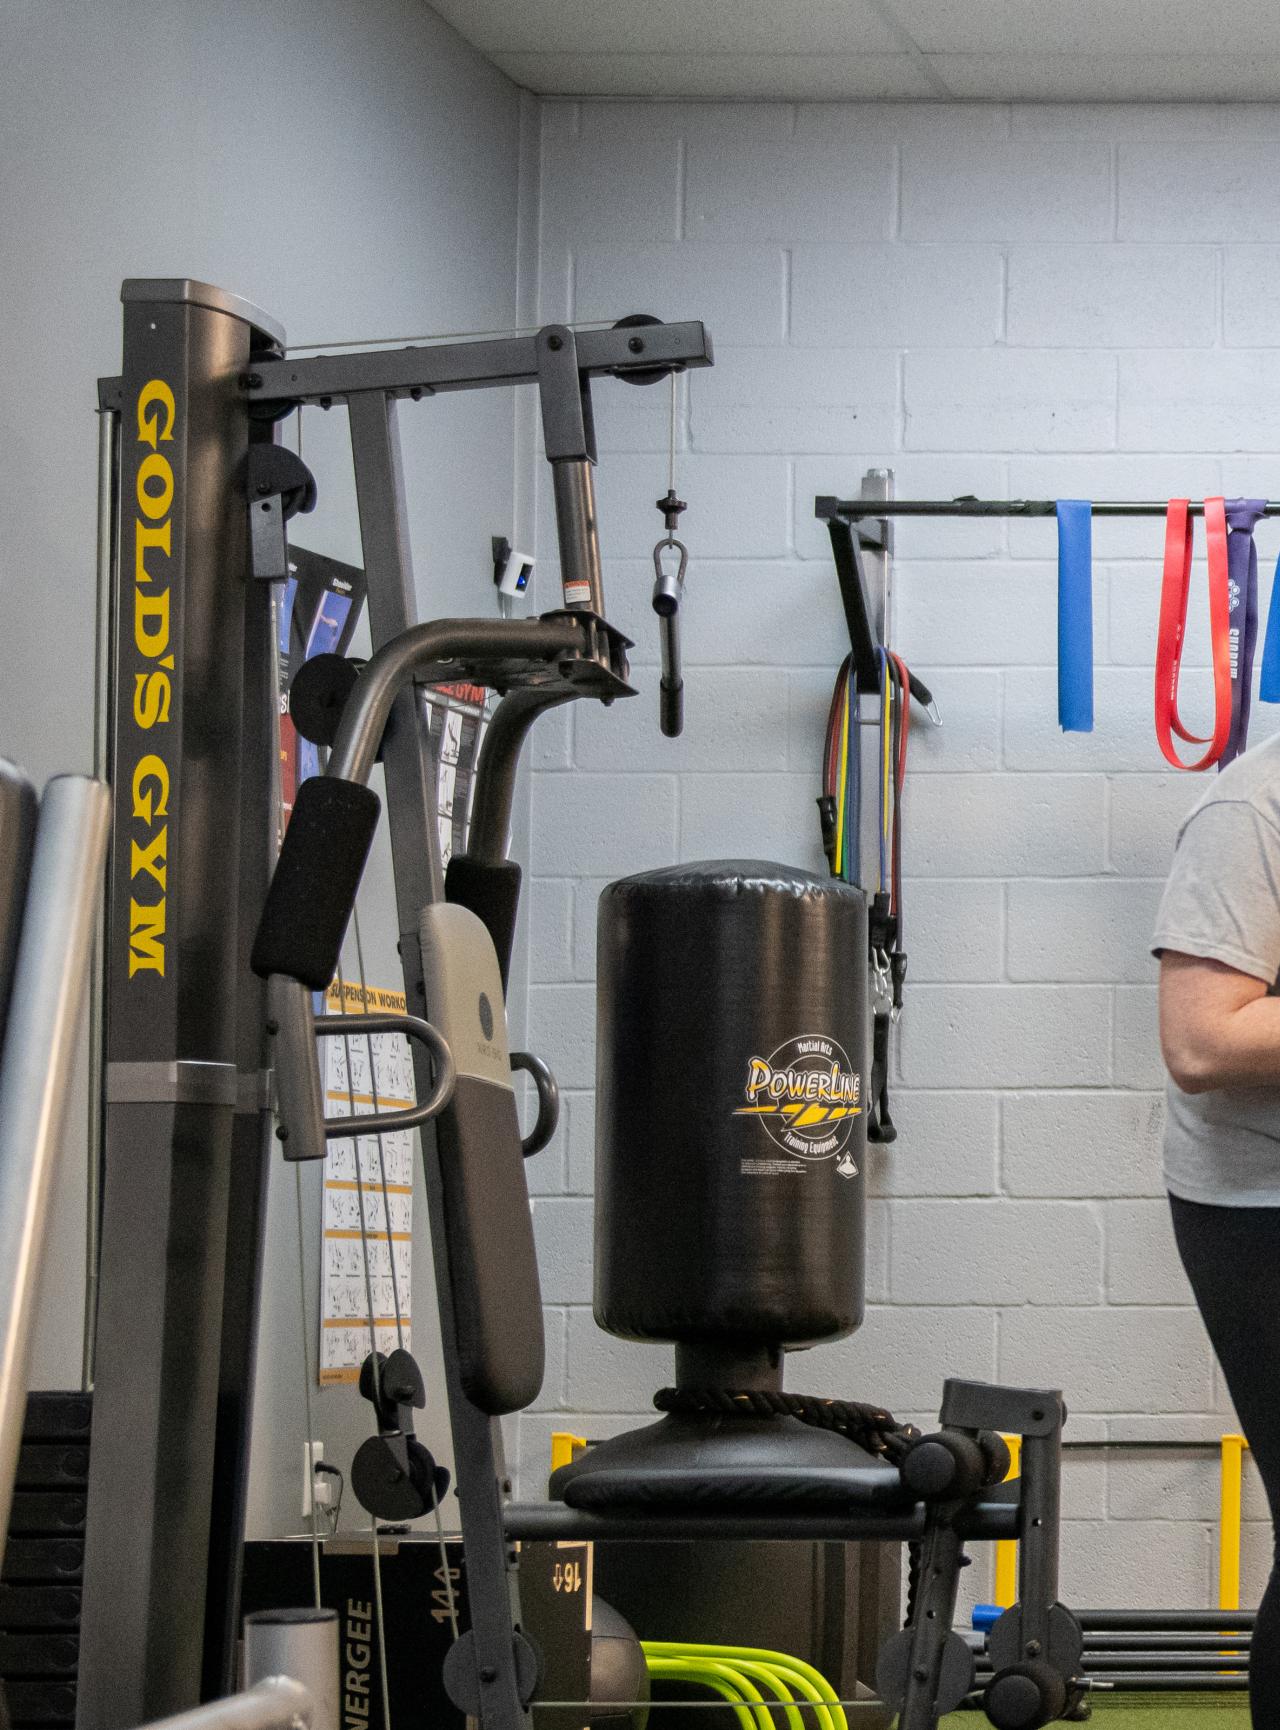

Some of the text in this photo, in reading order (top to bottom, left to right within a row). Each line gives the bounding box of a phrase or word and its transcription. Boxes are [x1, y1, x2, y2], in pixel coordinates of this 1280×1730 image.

[128, 379, 176, 979] GOLD'S GYM
[331, 981, 377, 1006] SUPENSON
[797, 1040, 832, 1055] Martial Arts
[784, 1131, 838, 1154] Training Equipment
[563, 1562, 582, 1593] 16
